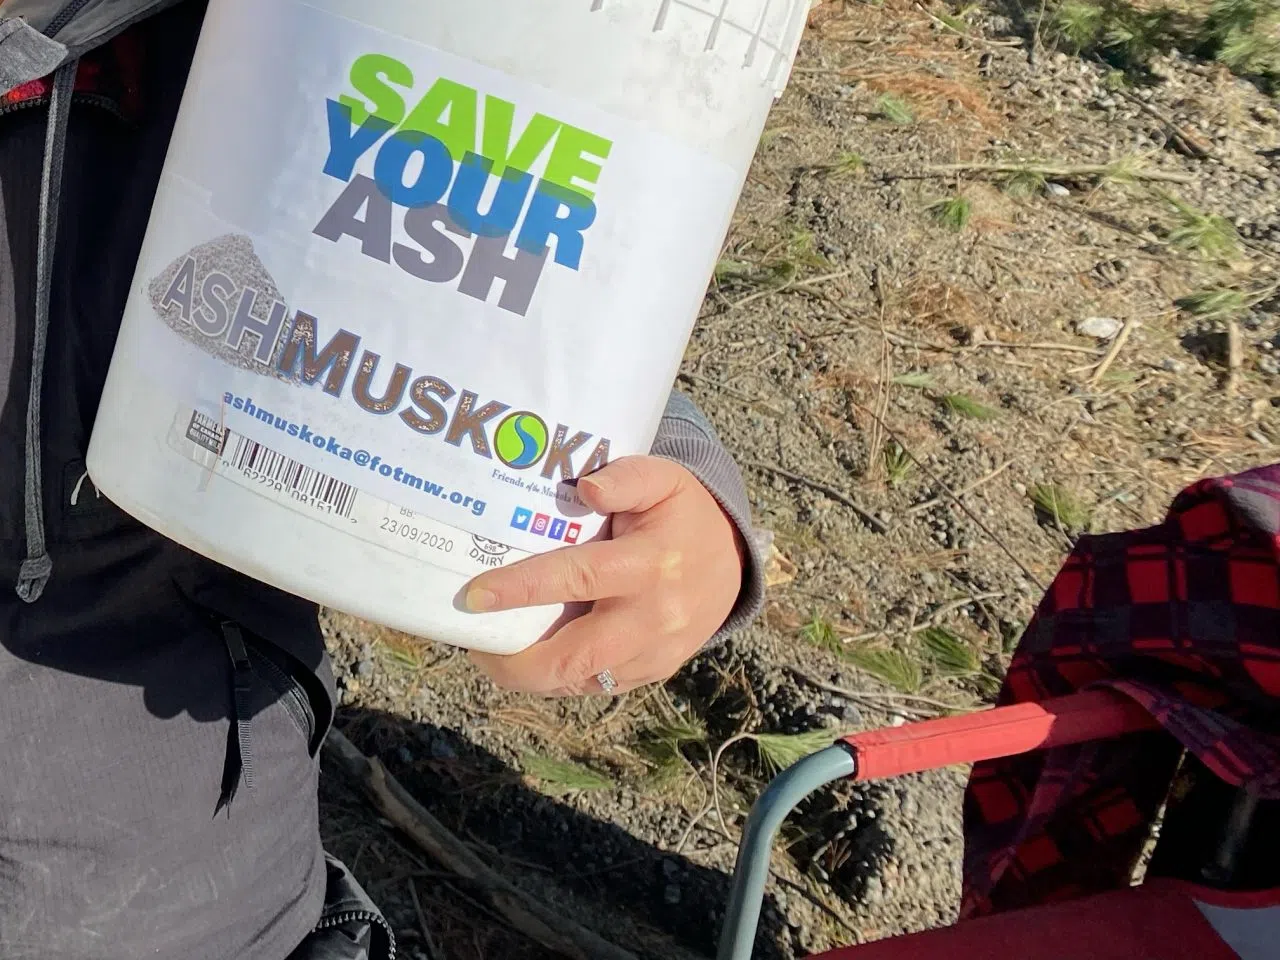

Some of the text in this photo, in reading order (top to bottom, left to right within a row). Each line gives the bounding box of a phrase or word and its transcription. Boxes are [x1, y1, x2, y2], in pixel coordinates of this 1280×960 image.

[322, 98, 597, 271] YOUR
[338, 53, 614, 210] SAVE
[311, 173, 553, 317] ASH
[223, 390, 487, 516] ashmuskoka@fotmw.org
[491, 468, 524, 487] Friends
[380, 517, 454, 553] 23/09/2020
[469, 547, 505, 567] DAIRY
